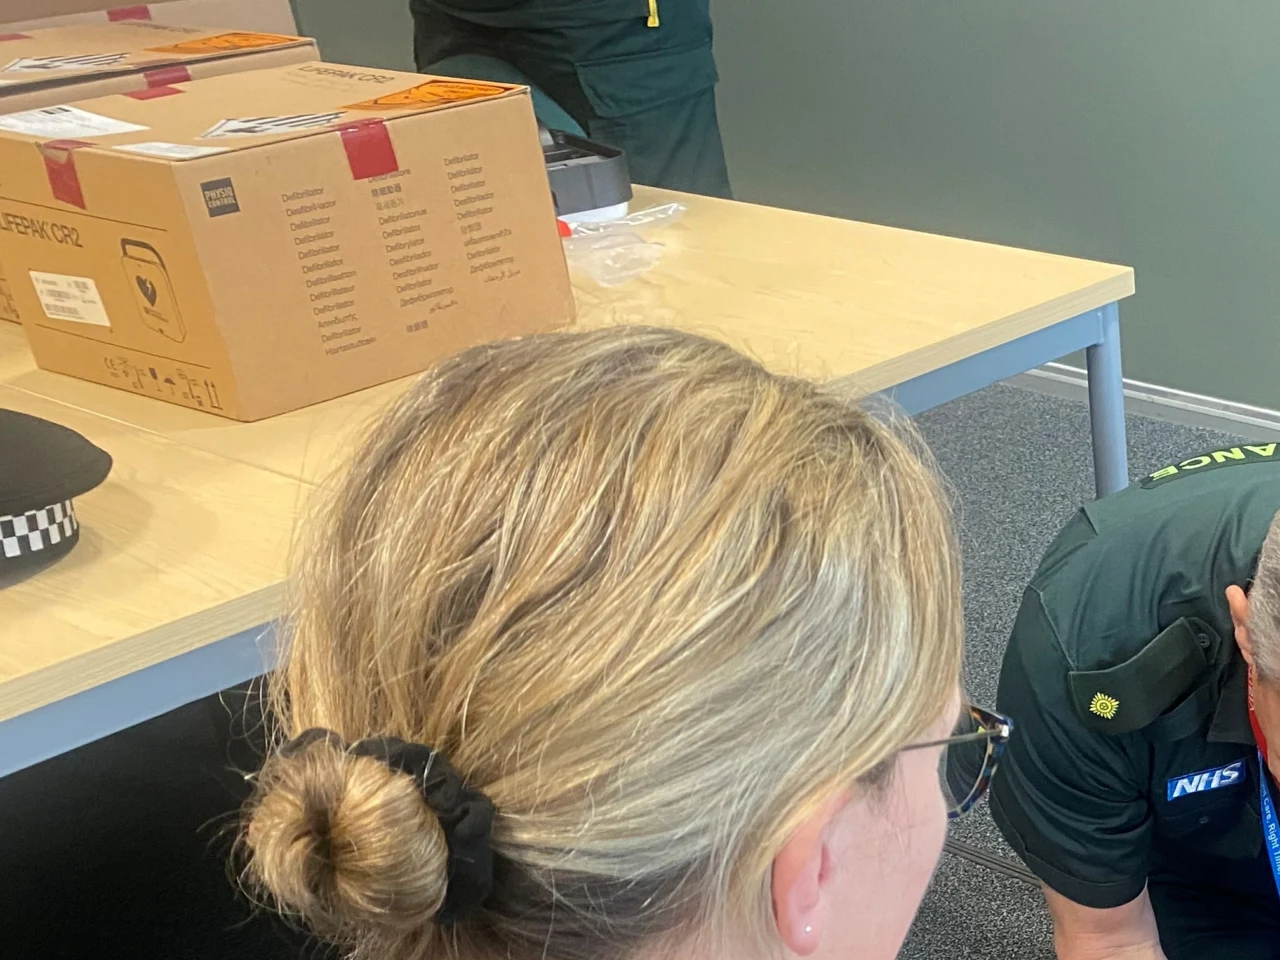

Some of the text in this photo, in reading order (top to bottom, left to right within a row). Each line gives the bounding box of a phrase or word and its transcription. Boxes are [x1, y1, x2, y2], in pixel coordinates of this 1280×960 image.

[204, 186, 234, 200] PHYSIO
[50, 222, 84, 248] CR2
[1173, 761, 1242, 798] NHS
[1267, 822, 1279, 854] Right
